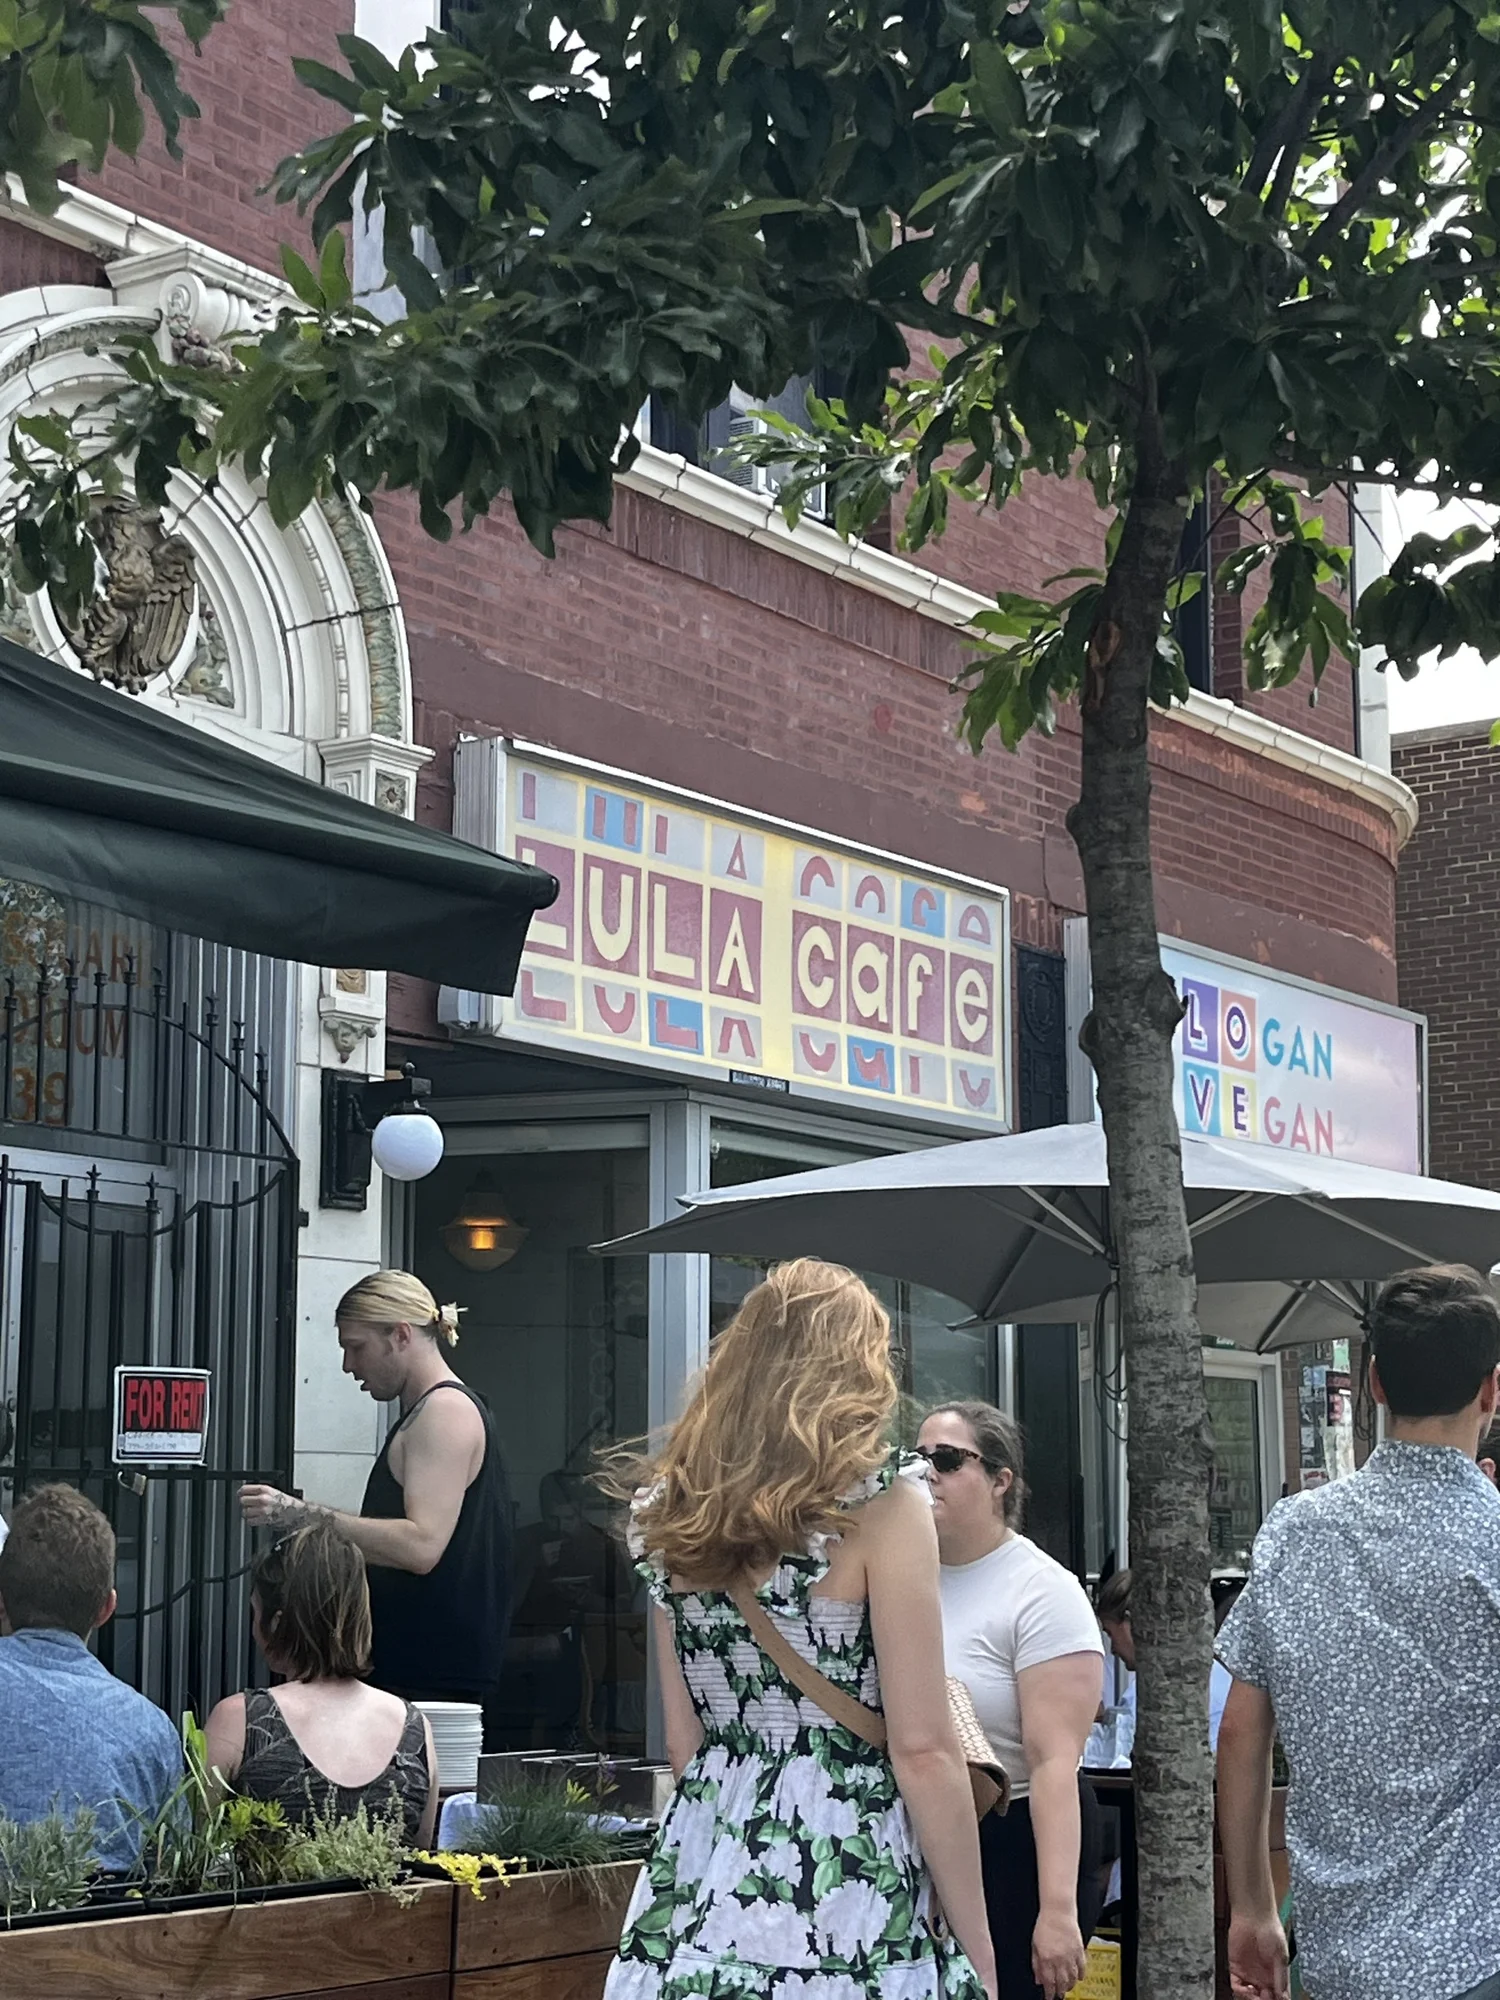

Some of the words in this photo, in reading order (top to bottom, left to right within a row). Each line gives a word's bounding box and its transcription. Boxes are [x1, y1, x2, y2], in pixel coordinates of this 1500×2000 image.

[521, 847, 755, 994] LULA
[1188, 990, 1333, 1082] LOGAN
[1189, 1073, 1335, 1157] VEGAN
[126, 1379, 165, 1429] FOR
